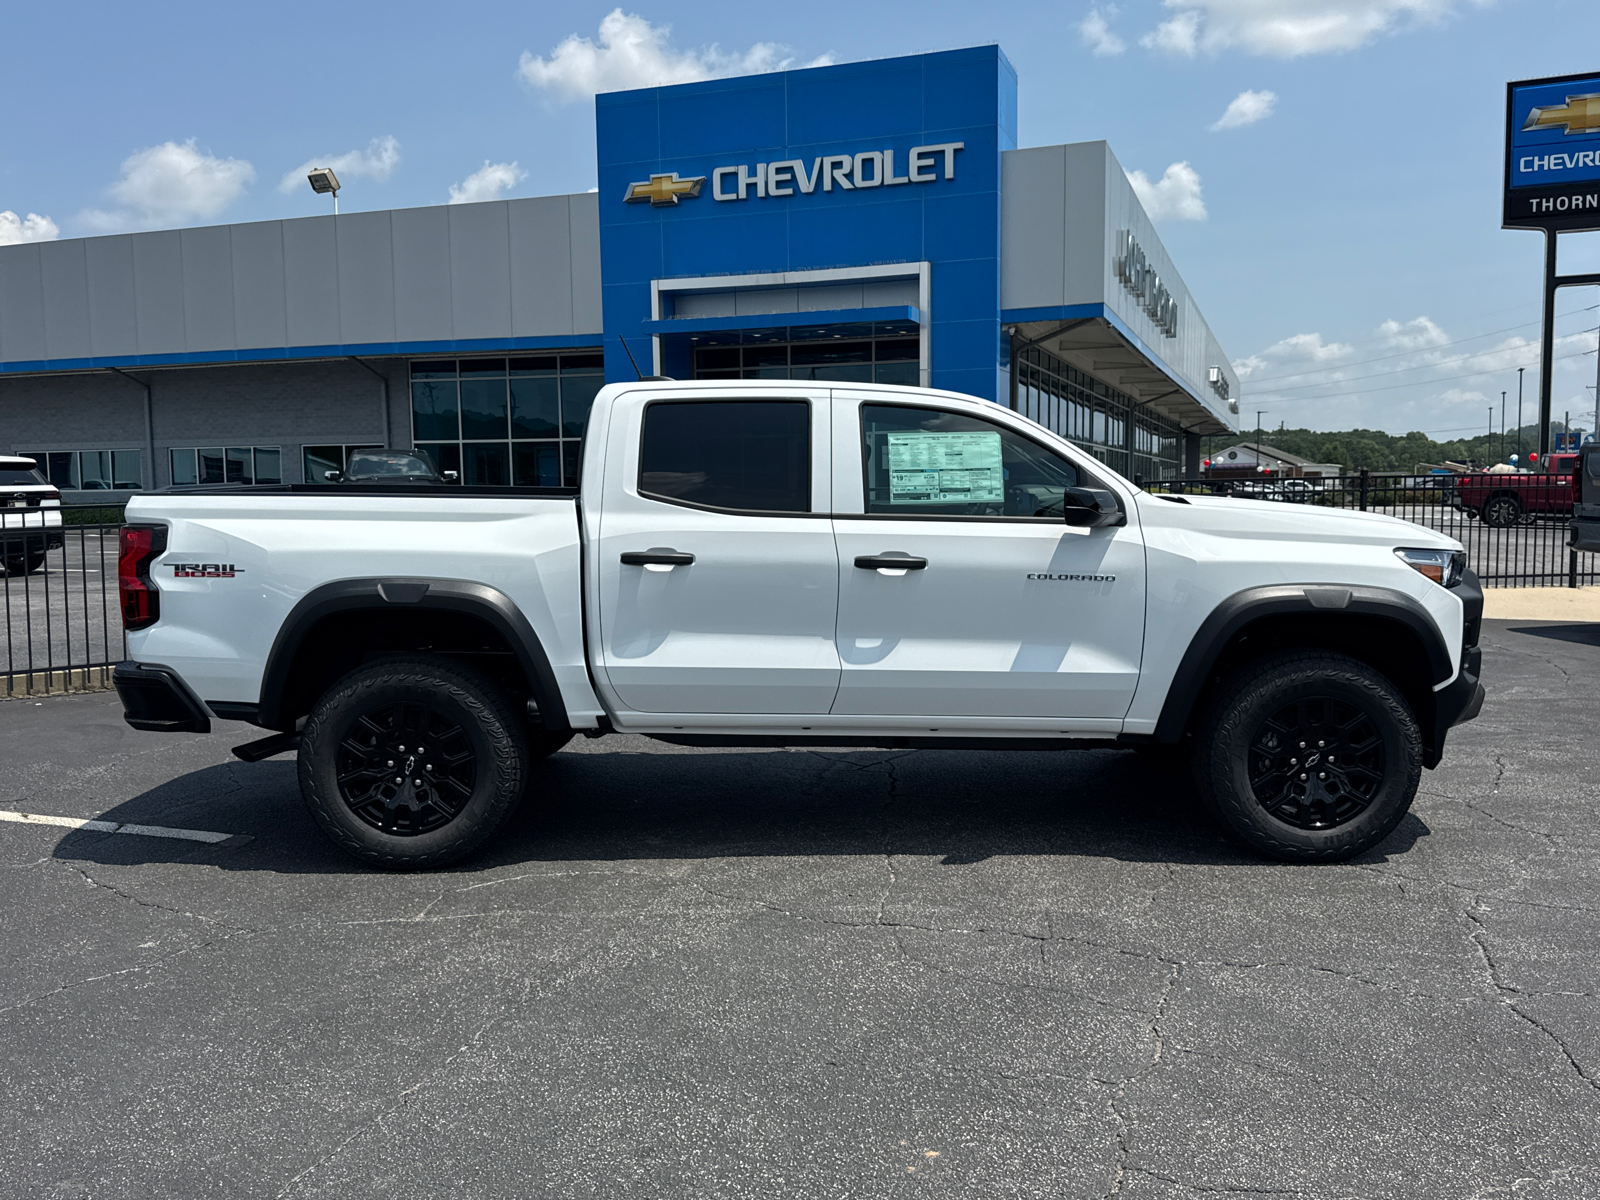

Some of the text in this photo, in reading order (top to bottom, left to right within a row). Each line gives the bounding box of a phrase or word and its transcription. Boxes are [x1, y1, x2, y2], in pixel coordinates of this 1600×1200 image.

[712, 142, 965, 201] CHEVROLET
[1529, 194, 1598, 213] THORN
[163, 564, 245, 572] TRAIL
[1026, 573, 1116, 582] COLORADO
